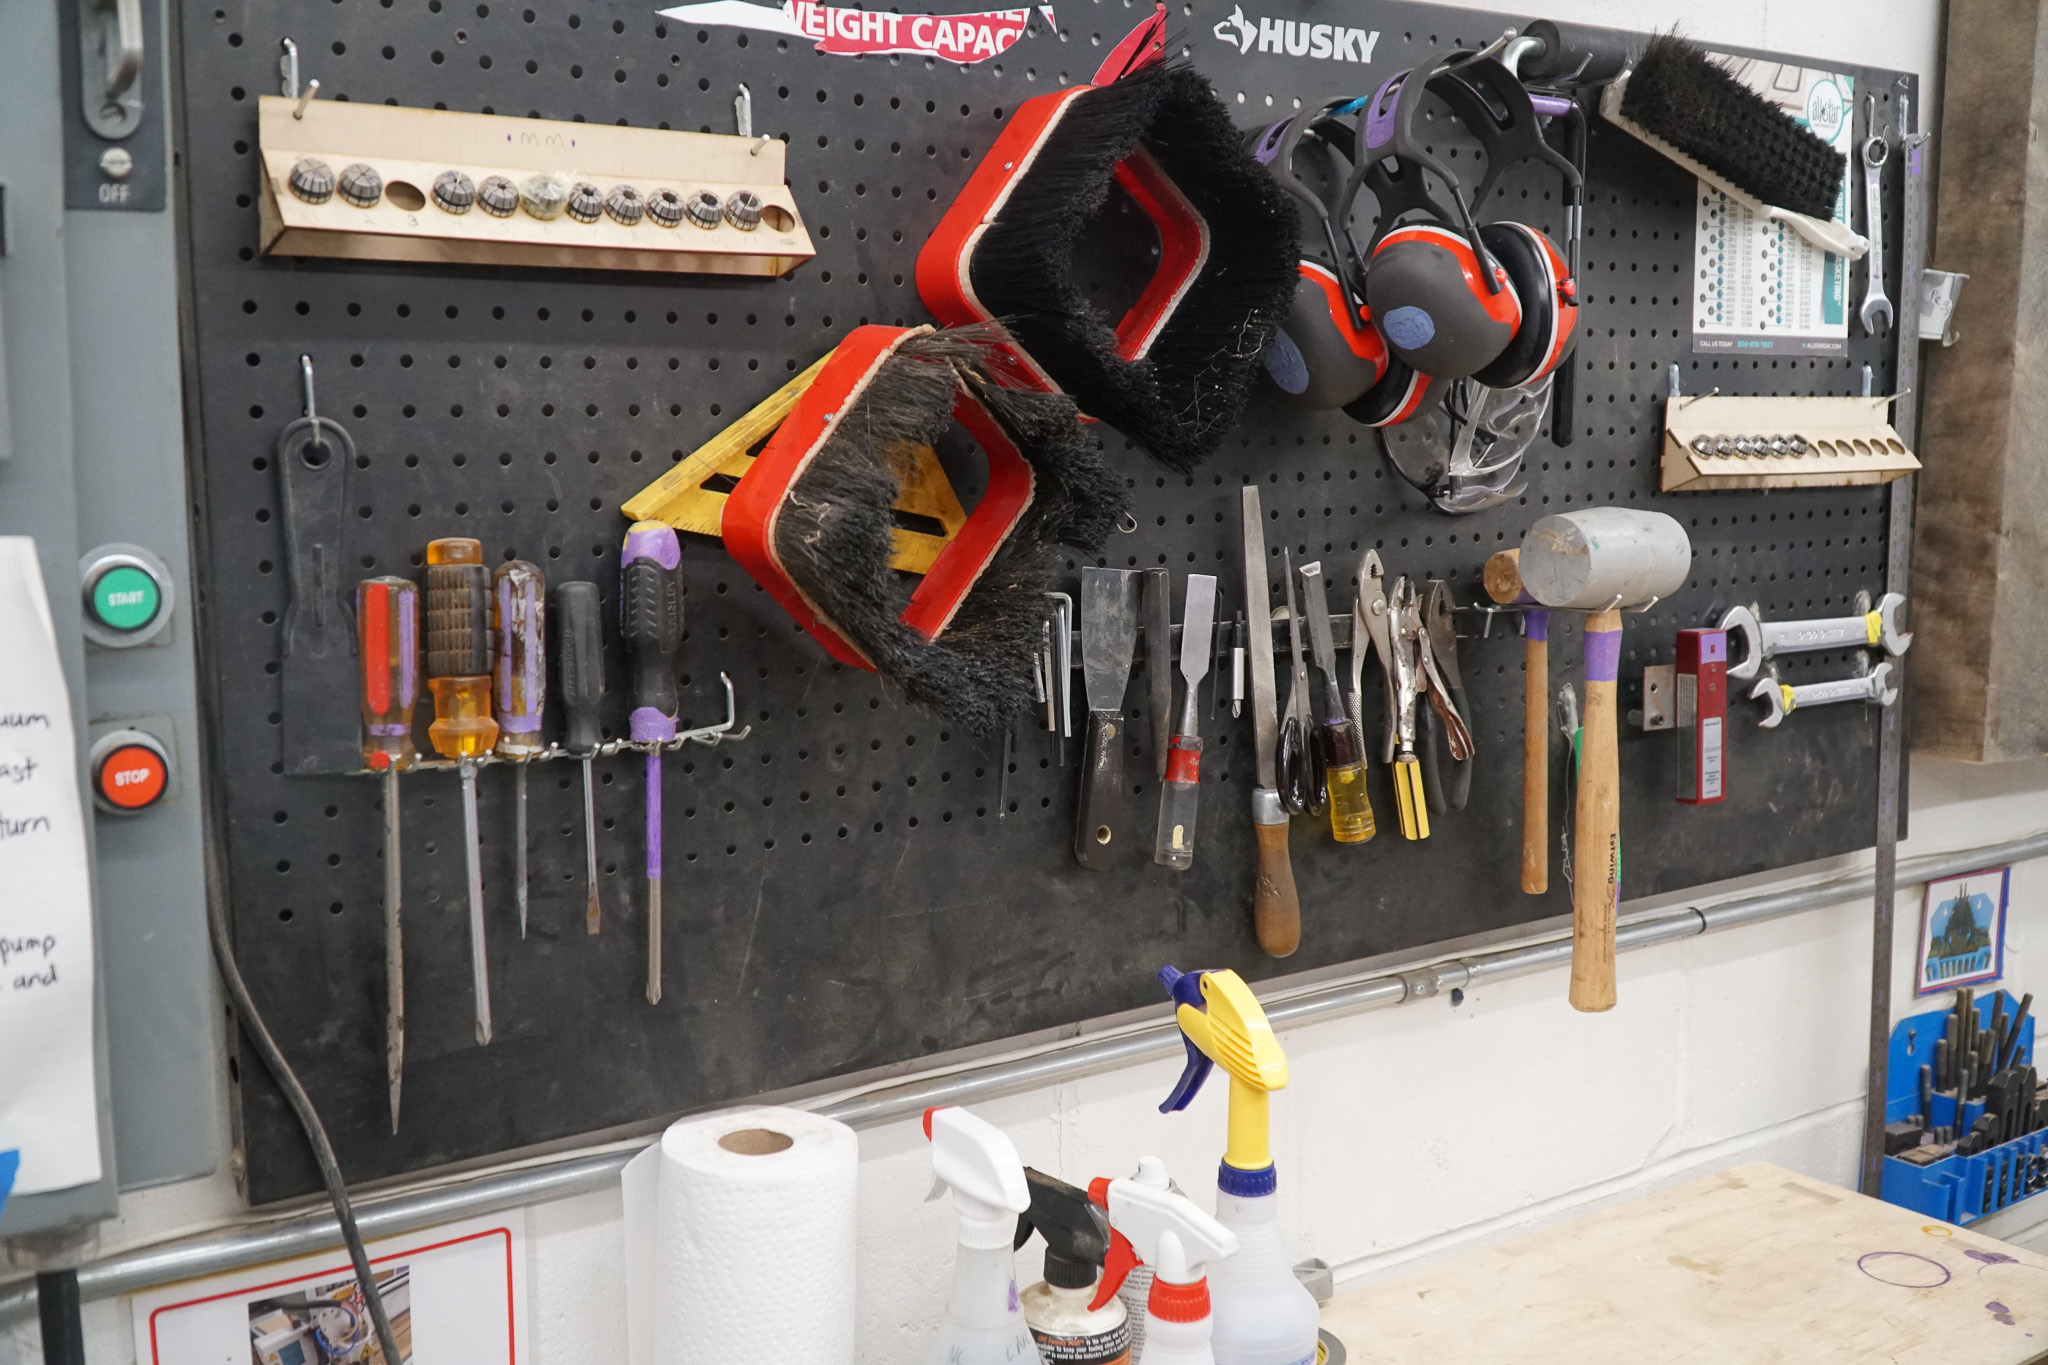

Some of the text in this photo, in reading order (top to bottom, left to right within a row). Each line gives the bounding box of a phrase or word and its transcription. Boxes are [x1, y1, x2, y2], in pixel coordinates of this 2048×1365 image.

[1258, 17, 1380, 64] HUSKY
[99, 183, 131, 203] OFF
[406, 214, 419, 227] 3
[704, 231, 721, 245] 10
[108, 590, 144, 607] START
[115, 768, 150, 787] STOP
[1608, 833, 1616, 884] Estwing
[0, 934, 56, 967] pump
[13, 963, 58, 990] and
[1037, 1342, 1055, 1352] vailable
[1063, 1345, 1075, 1355] keep
[1075, 1346, 1087, 1355] your
[1056, 1352, 1069, 1360] used
